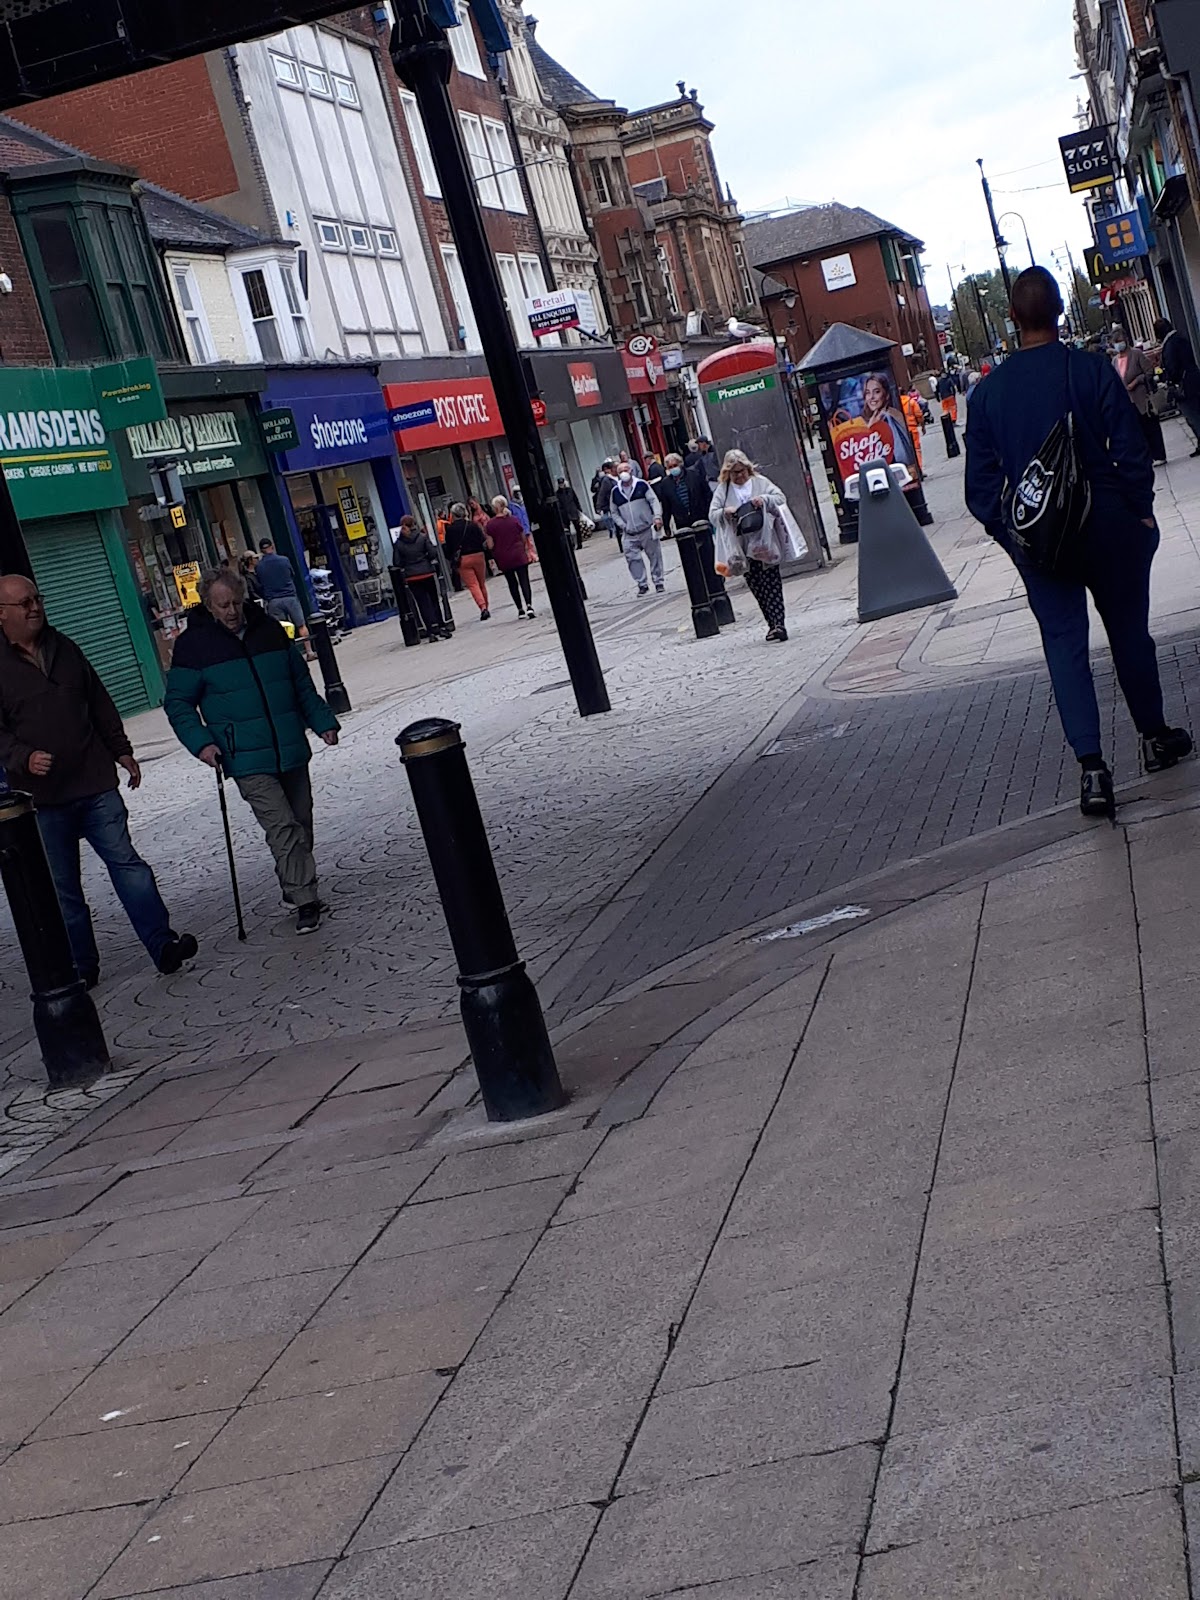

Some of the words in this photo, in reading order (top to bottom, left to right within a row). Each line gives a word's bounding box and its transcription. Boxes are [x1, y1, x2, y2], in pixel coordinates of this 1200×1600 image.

[1064, 140, 1104, 160] 777
[1068, 155, 1108, 174] SLOTS
[543, 293, 566, 306] retail
[531, 314, 542, 323] ALL
[542, 306, 575, 320] ENQUIRIES
[102, 383, 151, 398] Pawnbroking
[718, 379, 765, 400] Phonecard
[392, 407, 433, 423] shoezone
[433, 396, 459, 429] POST
[457, 393, 490, 426] OFFICE
[0, 409, 106, 450] RAMSDENS
[262, 416, 291, 431] HOLLAND
[310, 413, 368, 450] shoezone
[126, 417, 182, 459] HOLLAND
[189, 411, 242, 446] BARRETT
[265, 430, 293, 444] BARRETT
[840, 431, 881, 460] Shop
[853, 441, 892, 470] Sale
[51, 463, 75, 475] CASHING
[97, 460, 112, 471] GOLD
[1017, 479, 1043, 502] KING
[345, 510, 361, 525] FREE
